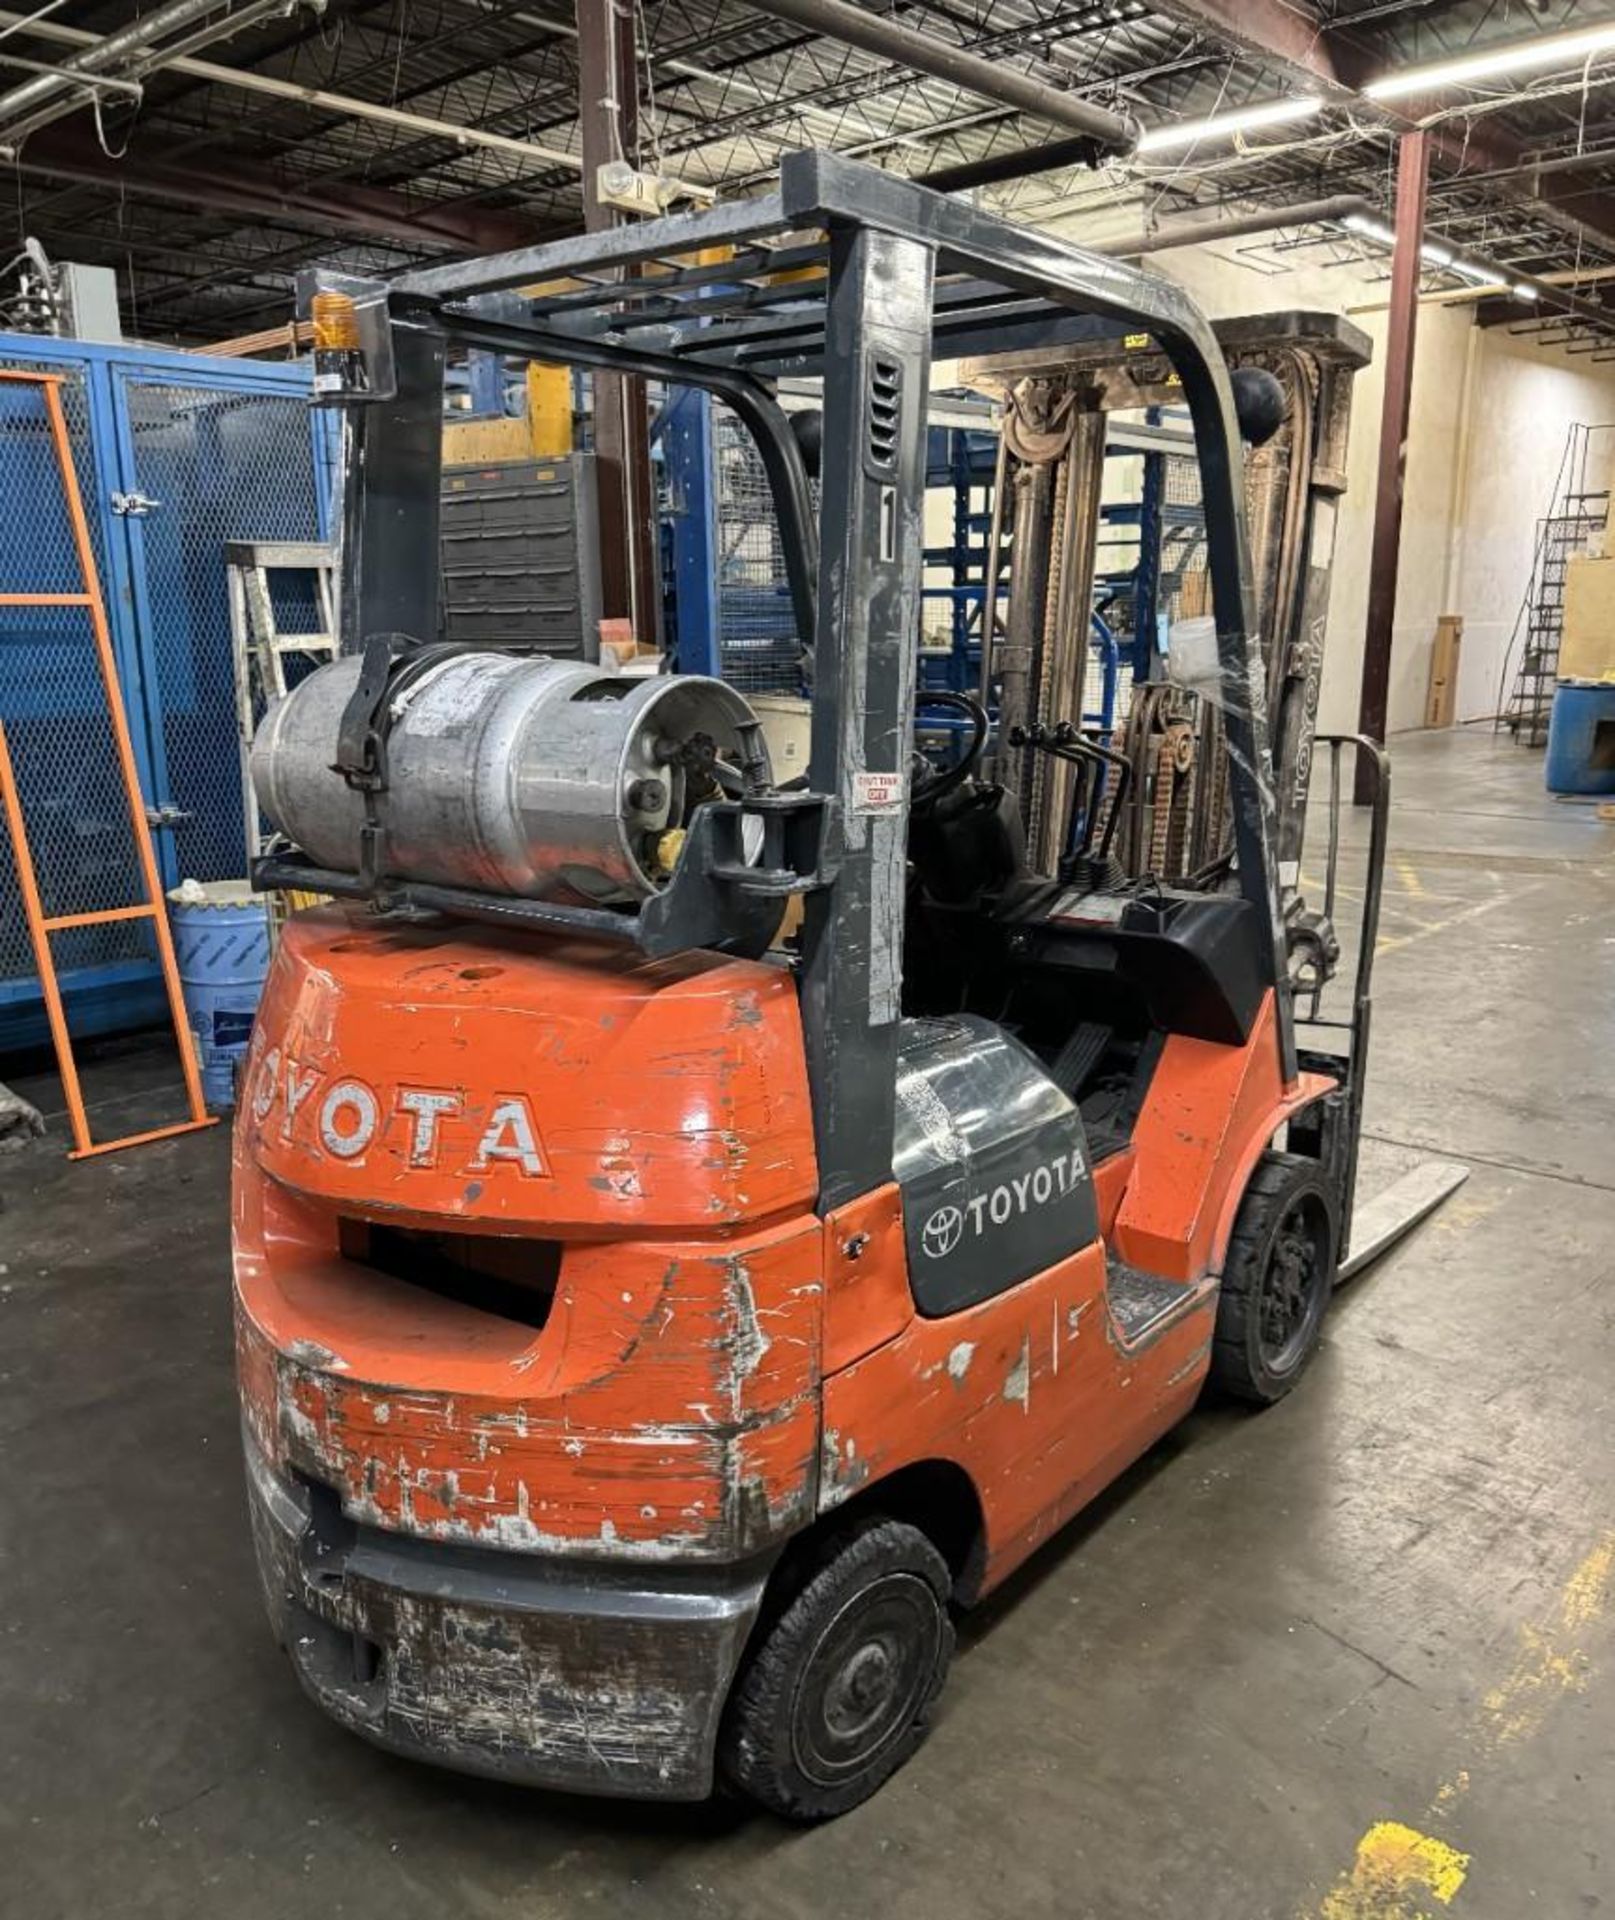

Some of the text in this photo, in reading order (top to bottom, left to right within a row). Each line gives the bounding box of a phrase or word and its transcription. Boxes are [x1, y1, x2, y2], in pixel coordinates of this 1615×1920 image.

[883, 489, 896, 560] 1
[1291, 614, 1326, 810] TOYOTA
[968, 1148, 1089, 1236] TOYOTA
